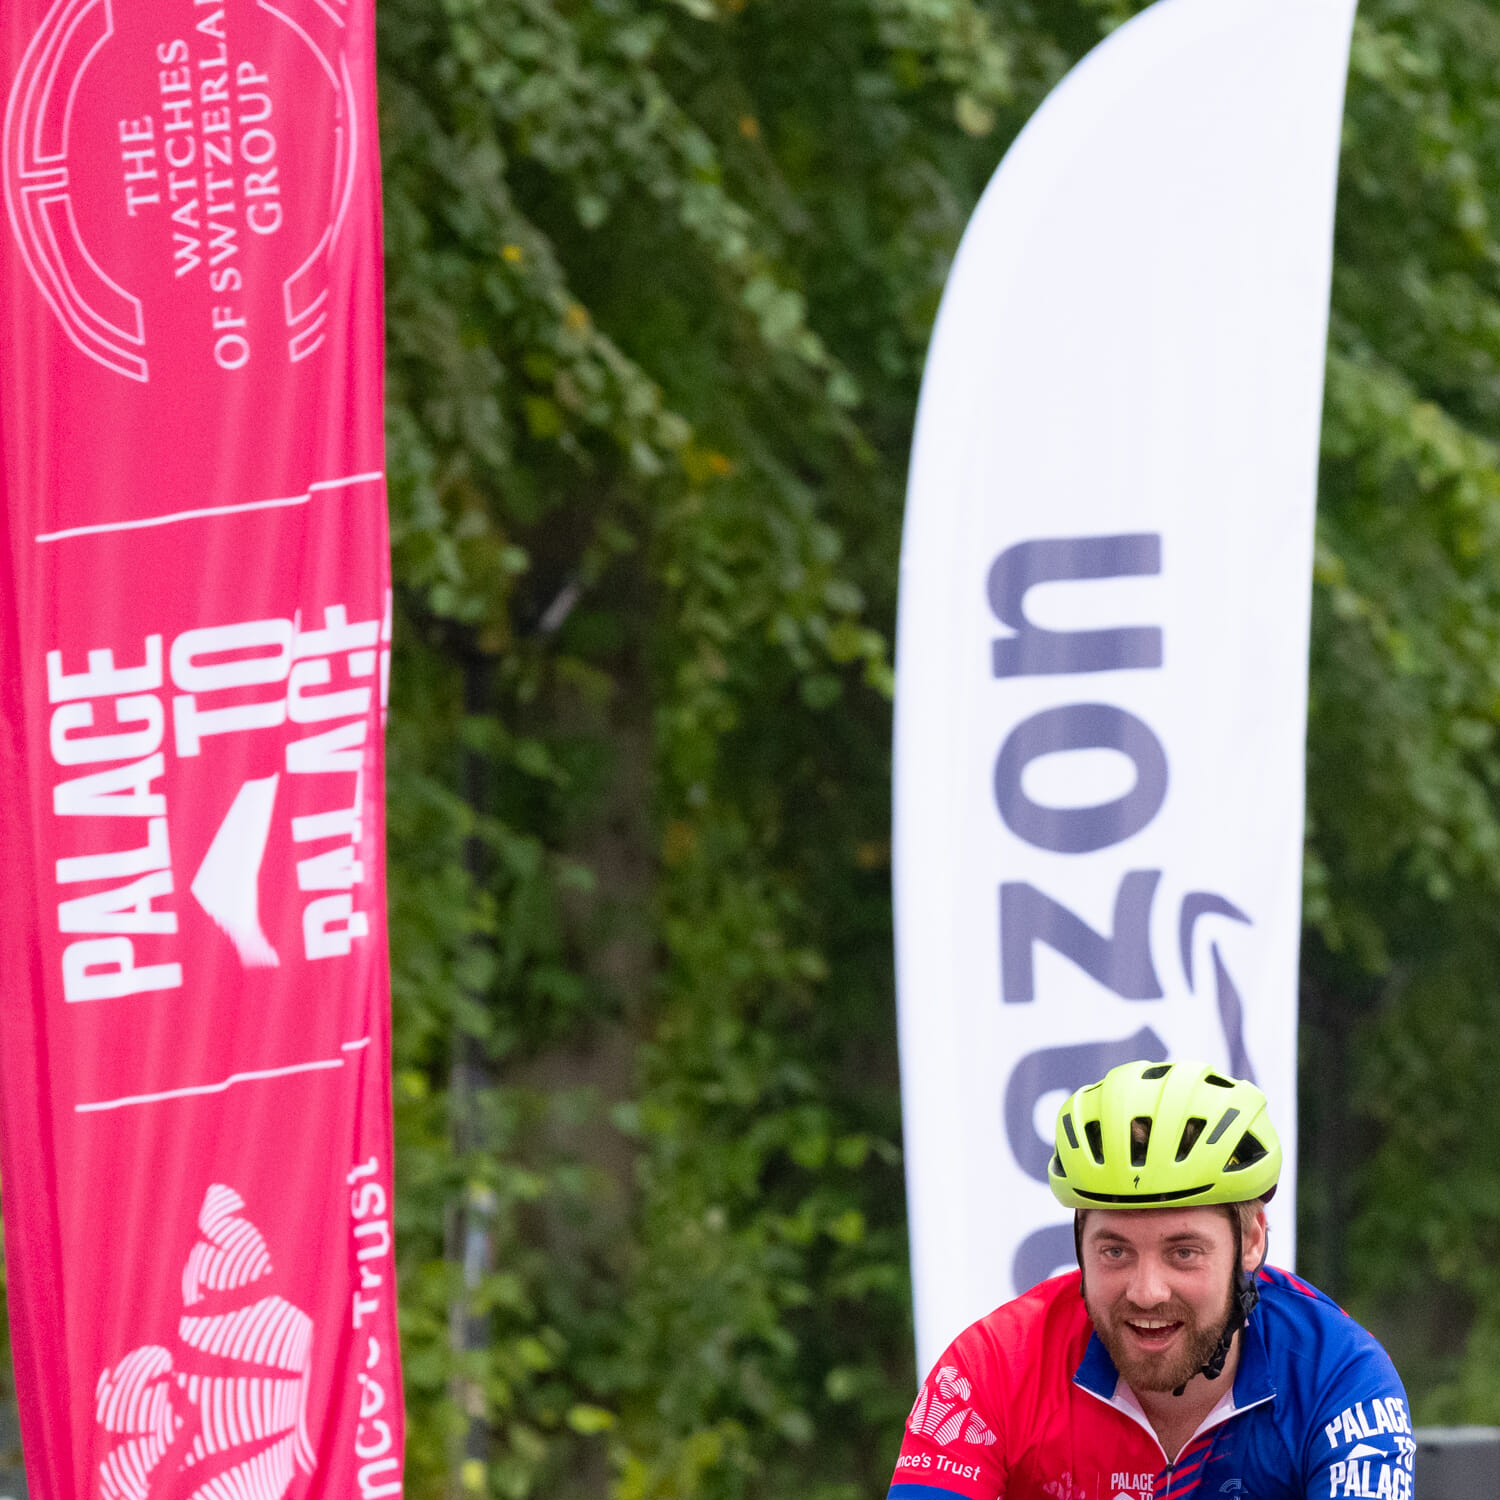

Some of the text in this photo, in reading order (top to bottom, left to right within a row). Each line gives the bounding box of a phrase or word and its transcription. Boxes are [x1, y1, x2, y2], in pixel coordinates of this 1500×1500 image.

[119, 115, 160, 216] THE
[158, 39, 201, 278] WATCHES
[196, 0, 250, 370] OF SWITZERLA
[237, 61, 283, 234] GROUP
[170, 618, 296, 757] TO
[47, 634, 182, 1003] PALACE
[987, 533, 1168, 1294] azon
[346, 1157, 390, 1330] Trust
[896, 1453, 980, 1481] nce's Trust
[1111, 1472, 1154, 1491] PALACE
[1325, 1397, 1411, 1449] PALACE
[1393, 1436, 1416, 1471] TO
